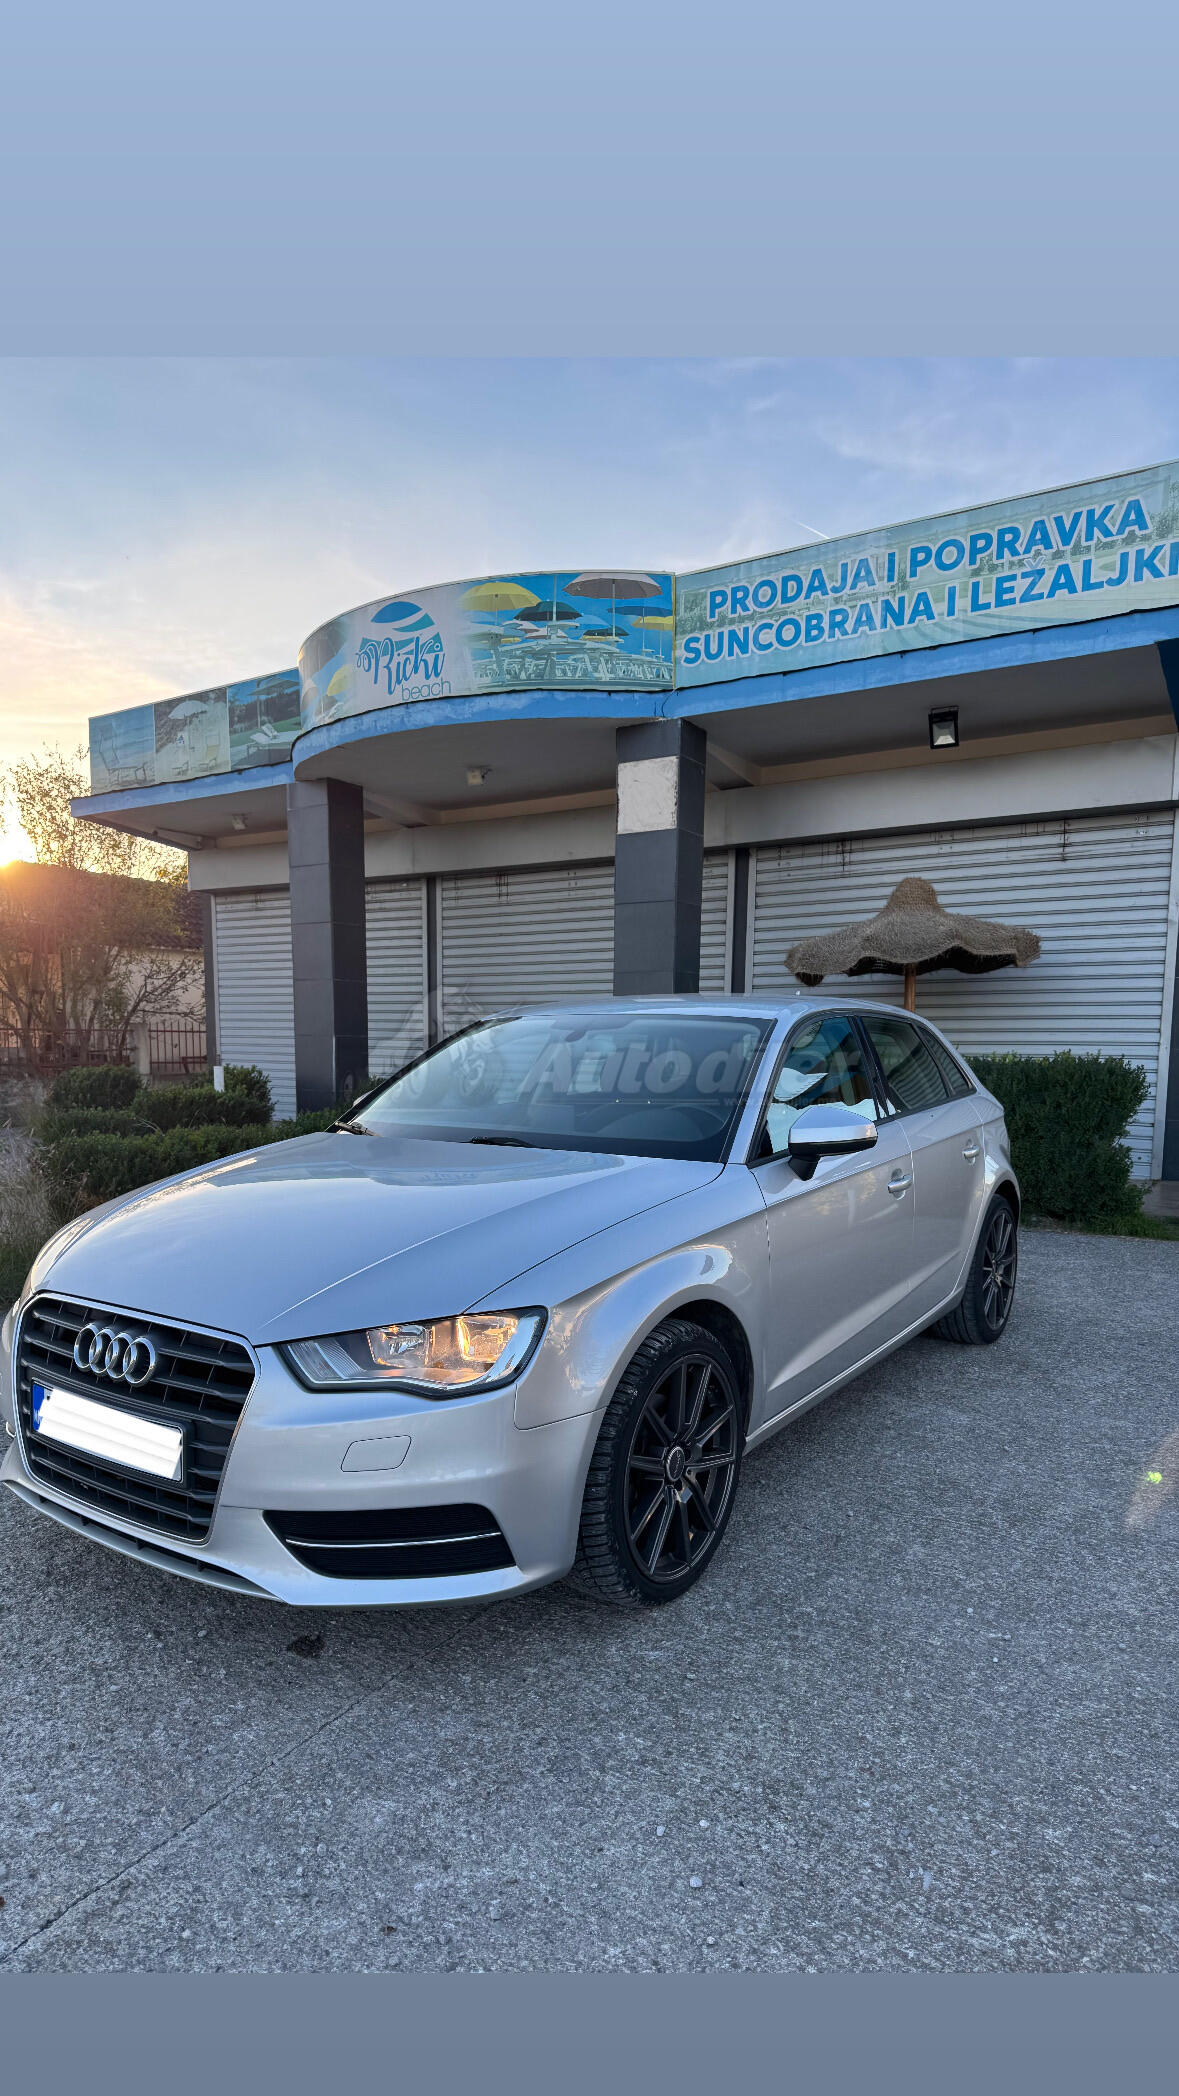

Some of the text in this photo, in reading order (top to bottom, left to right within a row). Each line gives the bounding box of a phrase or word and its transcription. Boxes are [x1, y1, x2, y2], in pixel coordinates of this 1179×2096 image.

[709, 499, 1149, 619] PRODAJA I POPRAVKA
[683, 592, 936, 665] SUNCOBRANA
[946, 586, 957, 617] I
[355, 636, 445, 695] Ricki
[402, 677, 452, 701] beach
